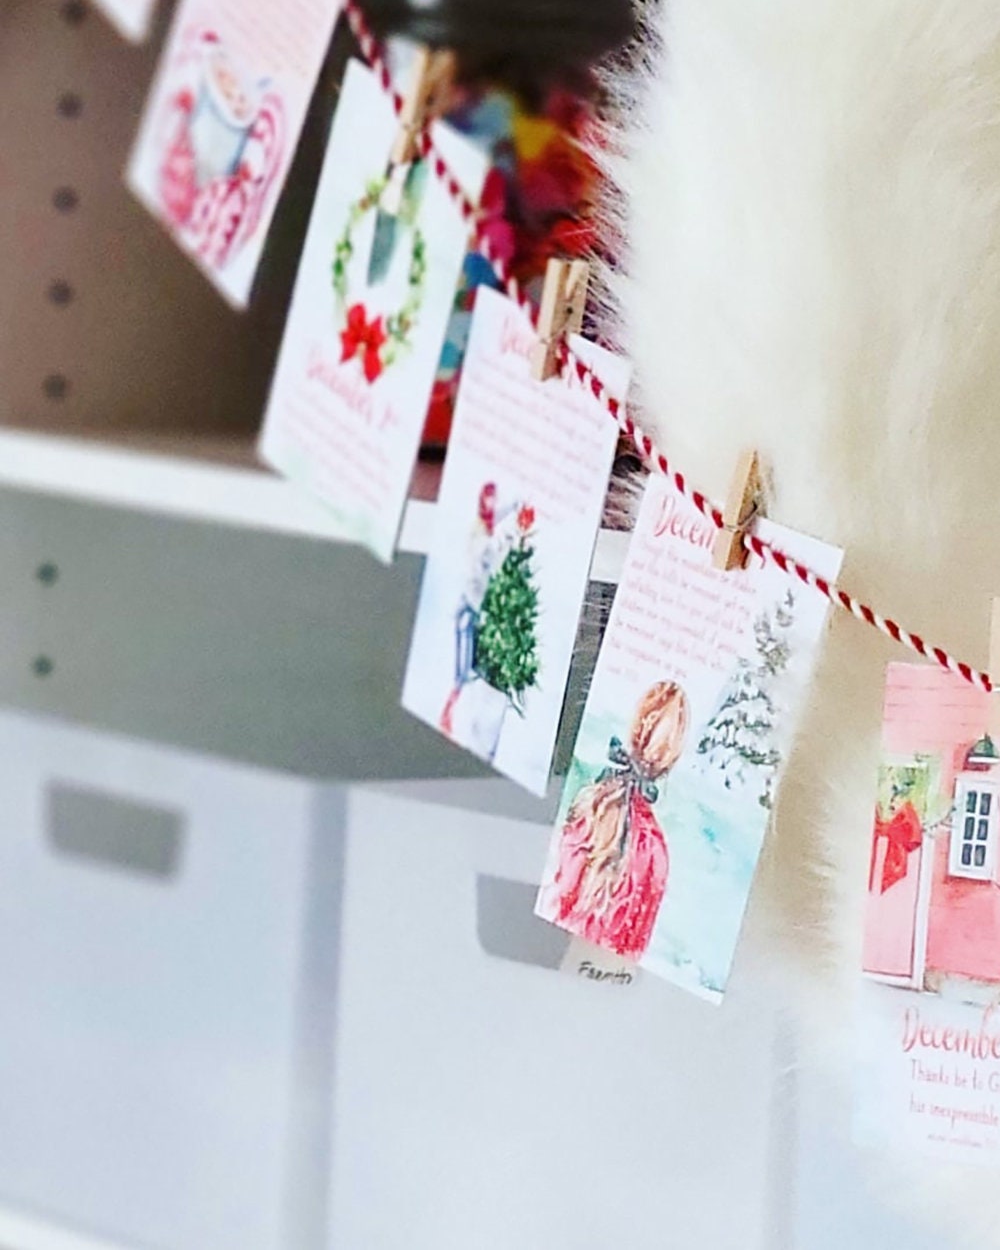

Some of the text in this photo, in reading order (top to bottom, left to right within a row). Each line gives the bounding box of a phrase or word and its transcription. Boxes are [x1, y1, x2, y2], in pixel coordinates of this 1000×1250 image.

[911, 1058, 950, 1086] Thanks
[954, 1065, 968, 1089] be
[972, 1067, 984, 1091] to
